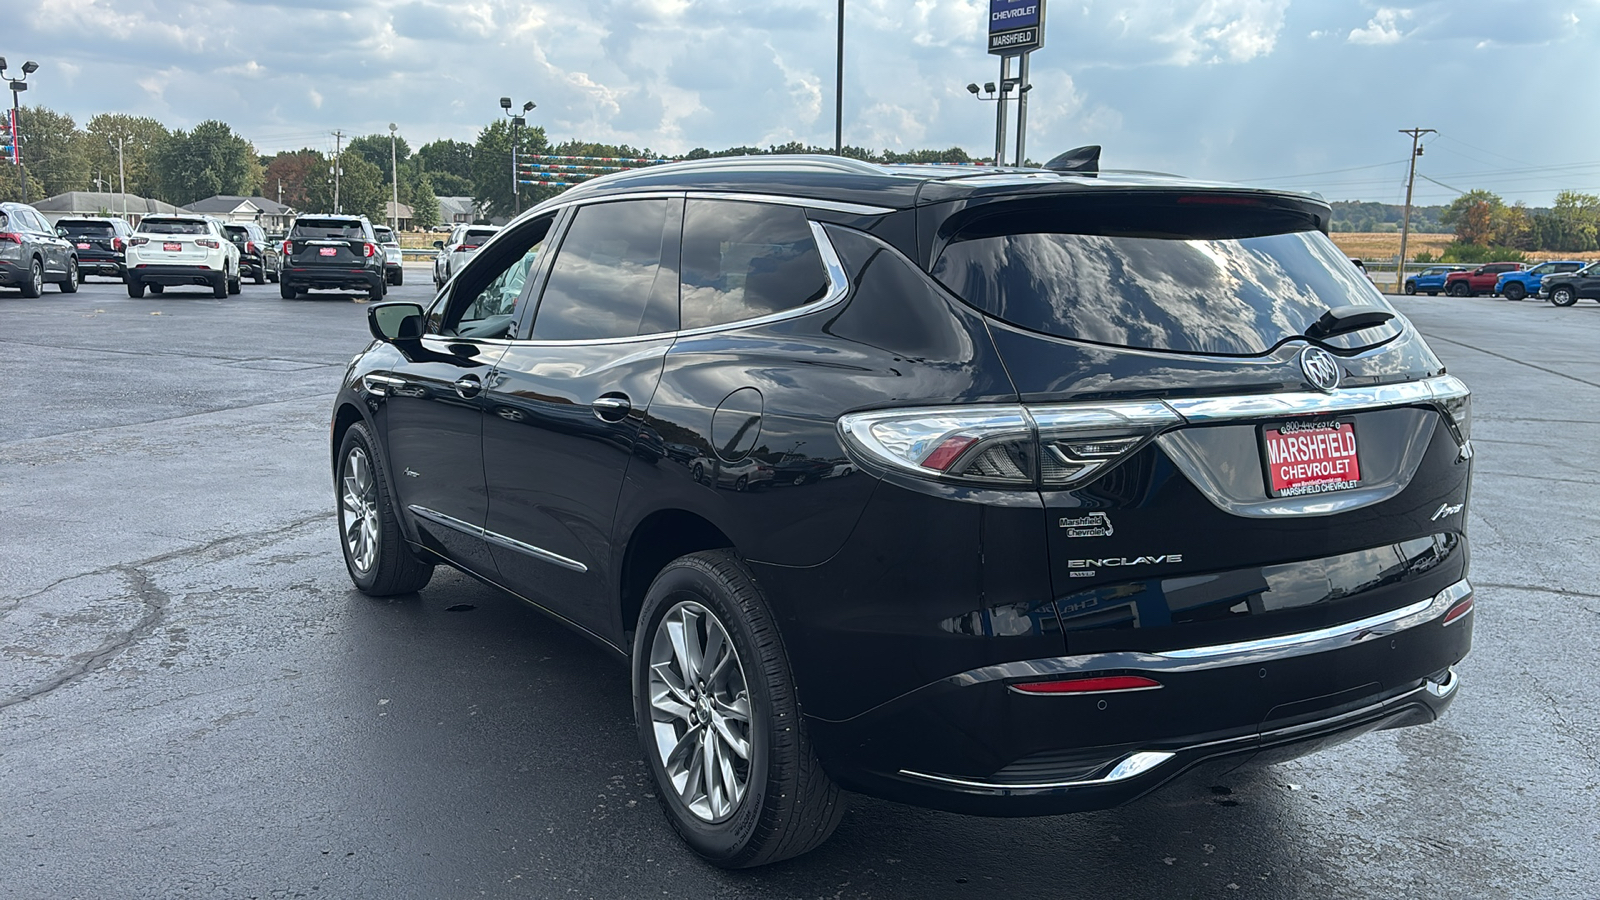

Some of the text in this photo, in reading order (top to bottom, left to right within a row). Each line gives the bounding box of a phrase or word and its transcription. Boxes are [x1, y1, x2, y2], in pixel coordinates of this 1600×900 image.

[992, 5, 1036, 21] CHEVROLET
[992, 31, 1031, 46] MARSHFIELD
[1267, 432, 1356, 465] MARSHFIELD
[1280, 459, 1350, 480] CHEVROLET
[1280, 480, 1357, 497] MARSHFIELD CHEVROLET
[1060, 517, 1102, 527] Marshfield
[1067, 528, 1105, 537] Chevrolet
[1067, 554, 1182, 568] ENCLAVE
